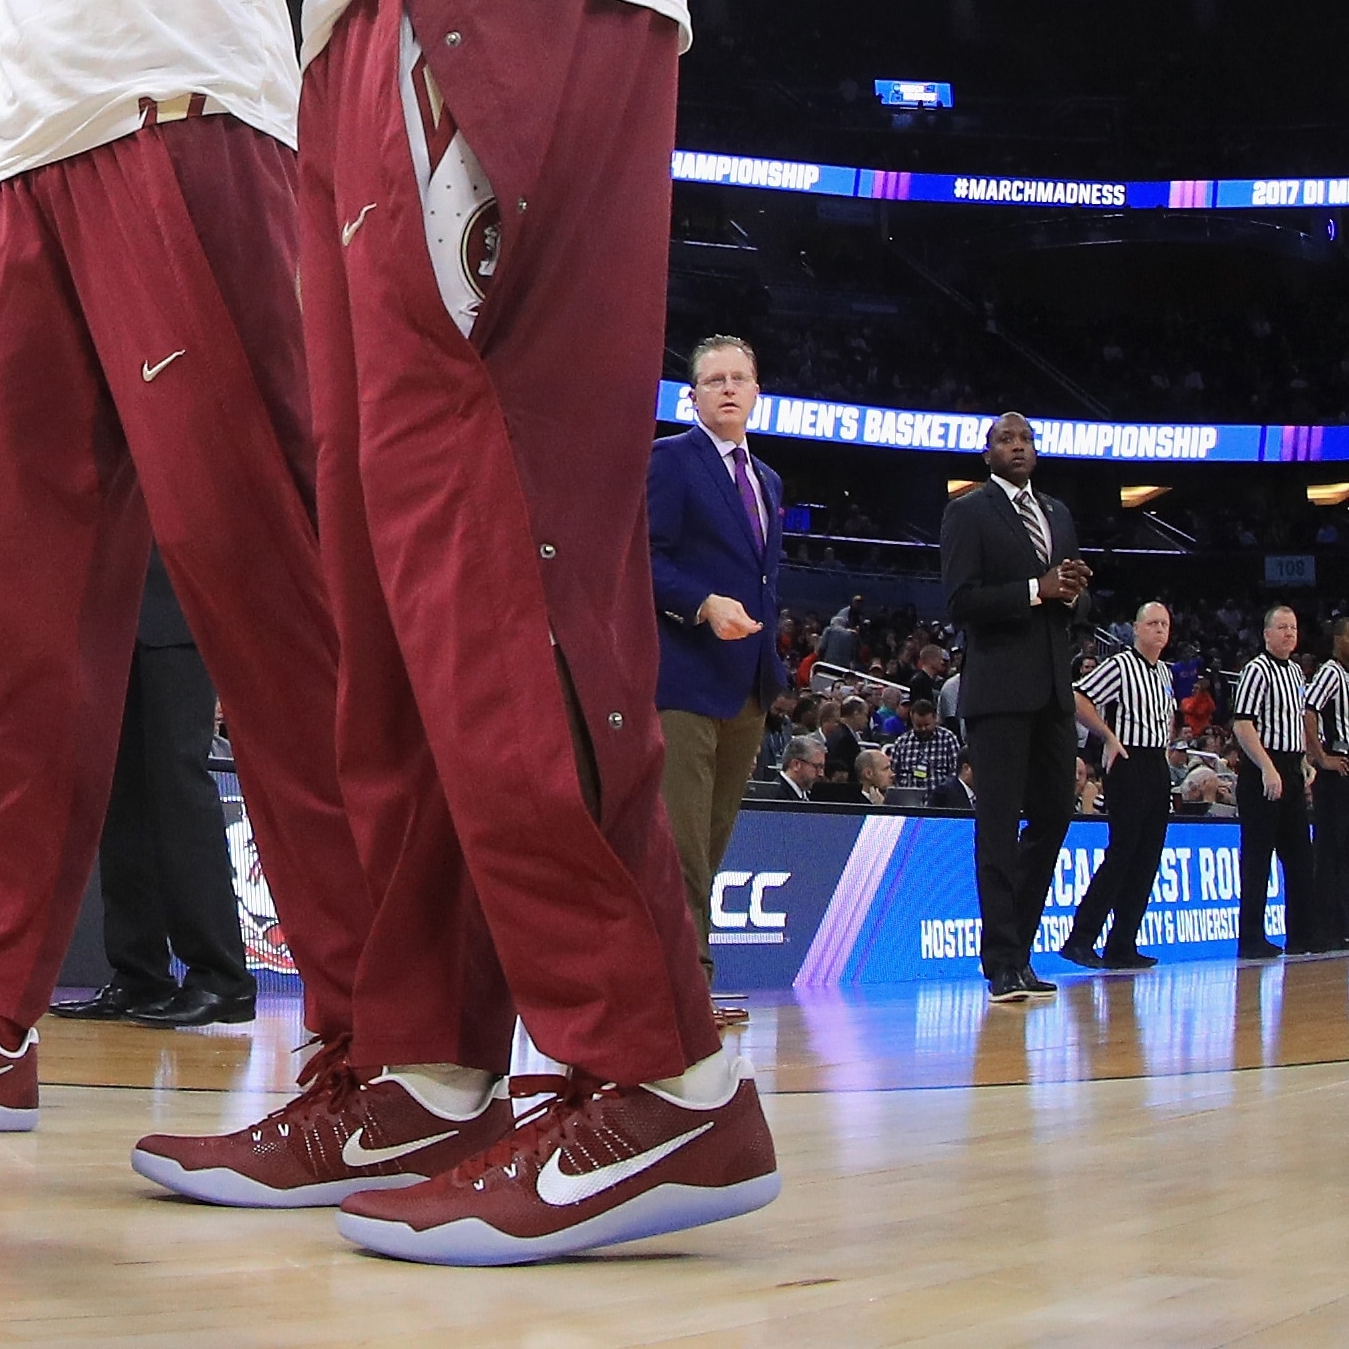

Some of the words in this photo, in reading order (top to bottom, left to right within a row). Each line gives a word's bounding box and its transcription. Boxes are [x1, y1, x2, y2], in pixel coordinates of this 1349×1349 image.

[953, 177, 1126, 207] #MARCHMADNESS
[1251, 180, 1300, 205] 2017
[1303, 180, 1324, 205] DI
[776, 399, 860, 441] MEN'S
